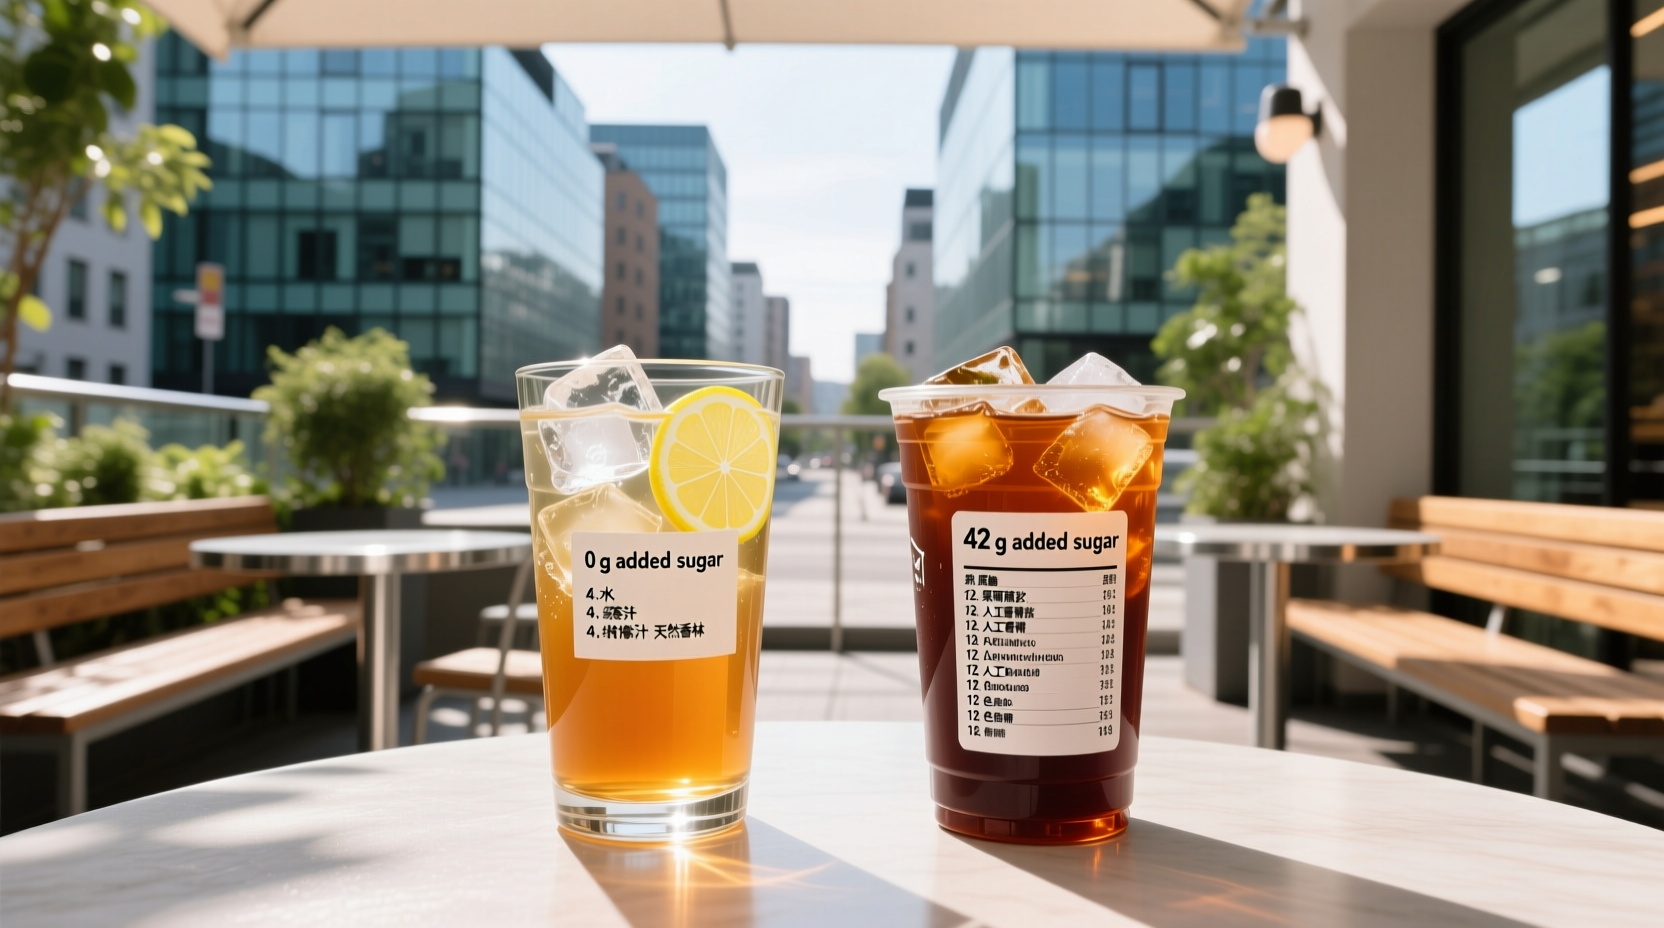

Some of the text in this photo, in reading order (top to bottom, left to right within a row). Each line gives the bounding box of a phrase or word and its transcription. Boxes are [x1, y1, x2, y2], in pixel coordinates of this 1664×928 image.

[963, 527, 1119, 556] 42 g added sugar
[585, 550, 724, 574] 0 g added sugar
